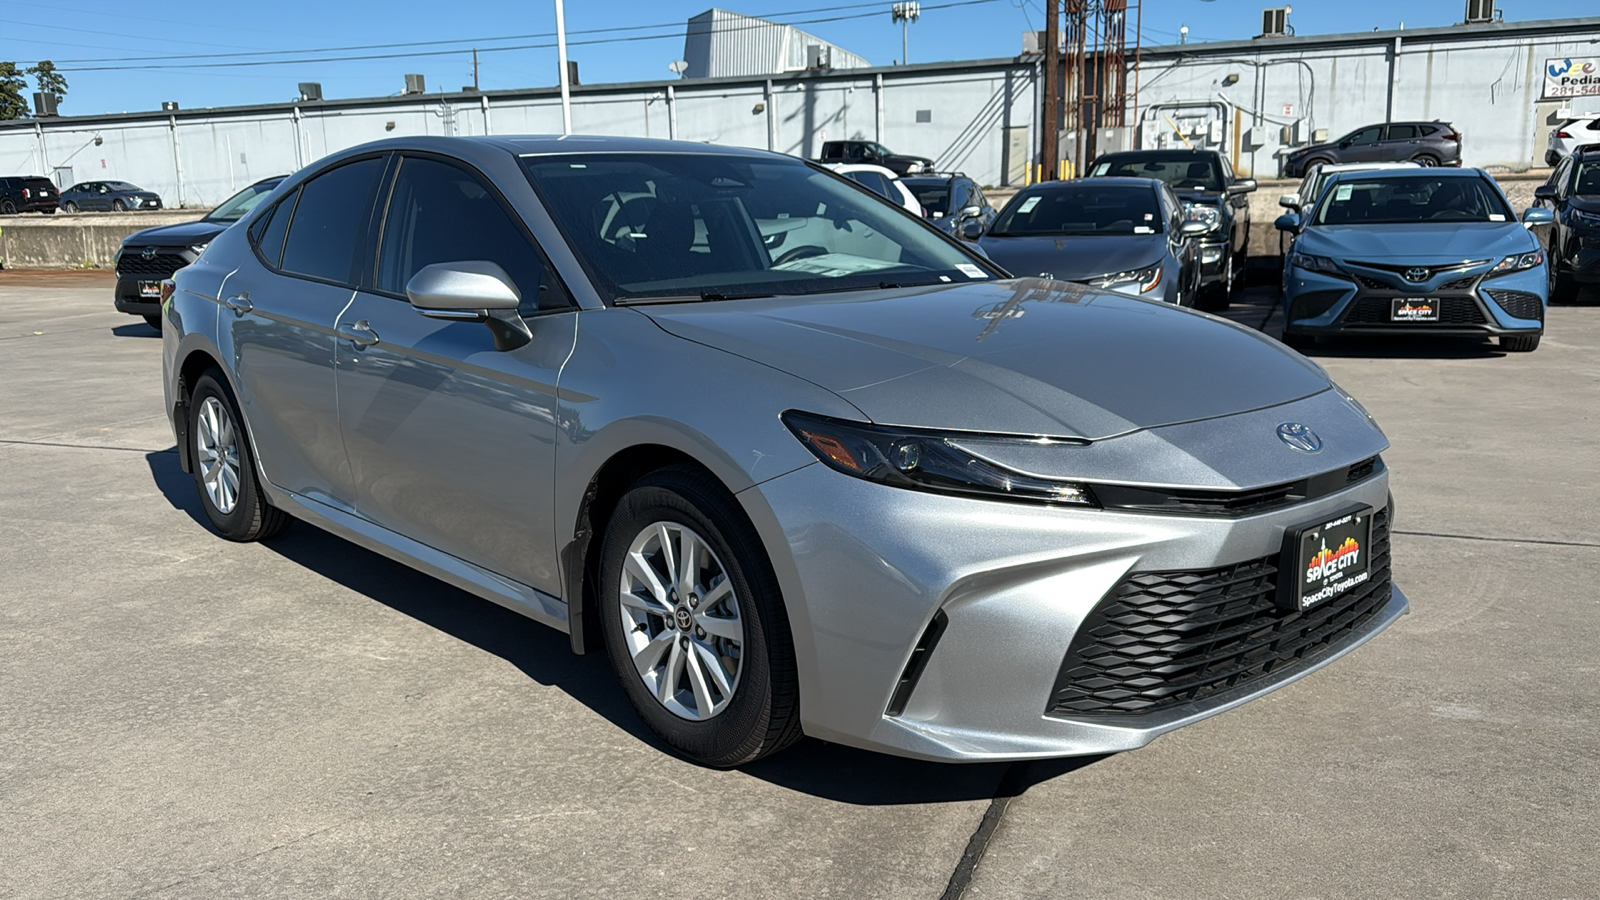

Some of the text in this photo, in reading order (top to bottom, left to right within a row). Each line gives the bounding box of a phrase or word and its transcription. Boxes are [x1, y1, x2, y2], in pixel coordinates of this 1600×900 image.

[1549, 58, 1596, 77] Wee
[1306, 549, 1359, 583] SPACE CITY
[1302, 572, 1367, 607] SpaceCityToyota.com
